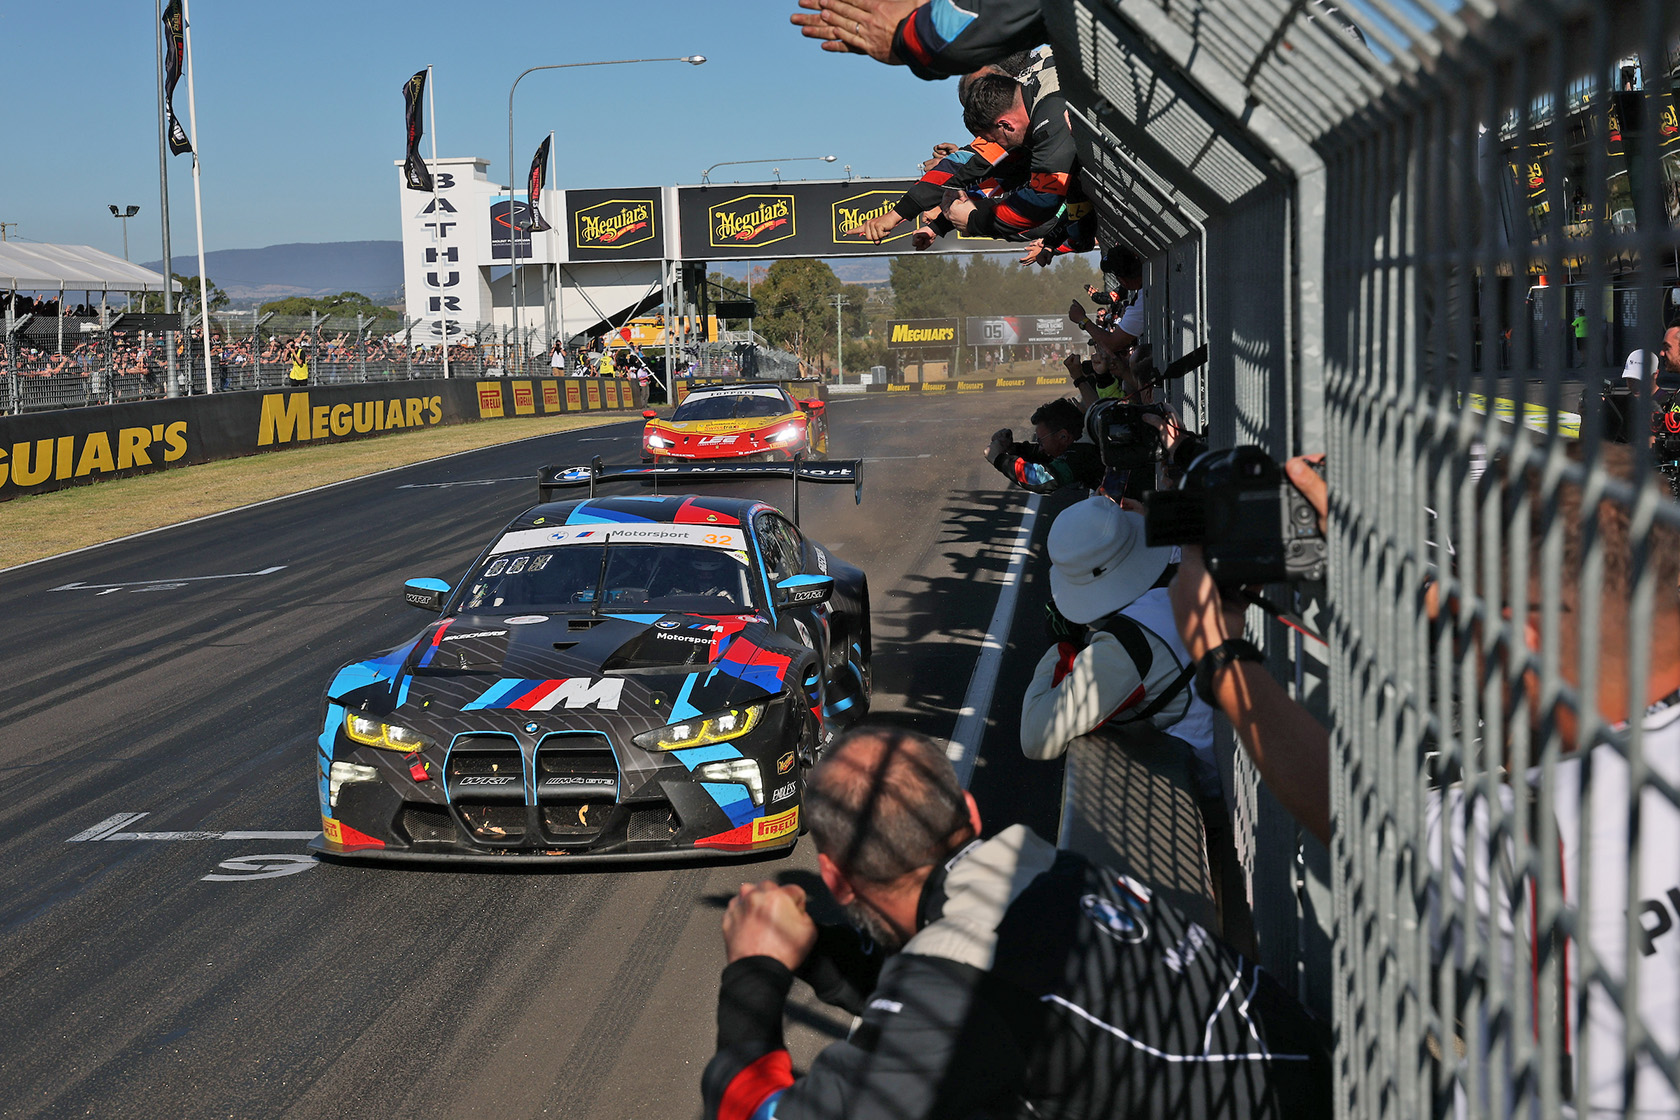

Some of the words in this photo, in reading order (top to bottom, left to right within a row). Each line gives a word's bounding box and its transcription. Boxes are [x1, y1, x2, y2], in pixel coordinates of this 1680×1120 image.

[581, 204, 648, 242] Meguiar's
[715, 199, 789, 240] Meguiar's
[422, 173, 462, 338] BATHURS
[891, 324, 955, 343] MEGUIAR'S
[984, 324, 1002, 338] 05
[957, 381, 984, 390] MEGUIAR'S
[996, 378, 1026, 387] MEGUIAR'S
[1036, 376, 1068, 385] MEGUIAR'S
[479, 390, 501, 409] PIRELLI
[515, 388, 533, 406] PIRELLI
[544, 388, 558, 404] PIRELLI
[257, 391, 443, 446] MEGUIAR'S
[0, 421, 188, 489] UIAR'S
[611, 529, 690, 541] Motorsport
[704, 533, 733, 546] 32
[406, 593, 432, 605] WRT
[794, 588, 827, 601] WRT
[656, 631, 717, 646] Motorsport
[459, 776, 516, 786] WRT
[757, 811, 797, 836] PIRELLI
